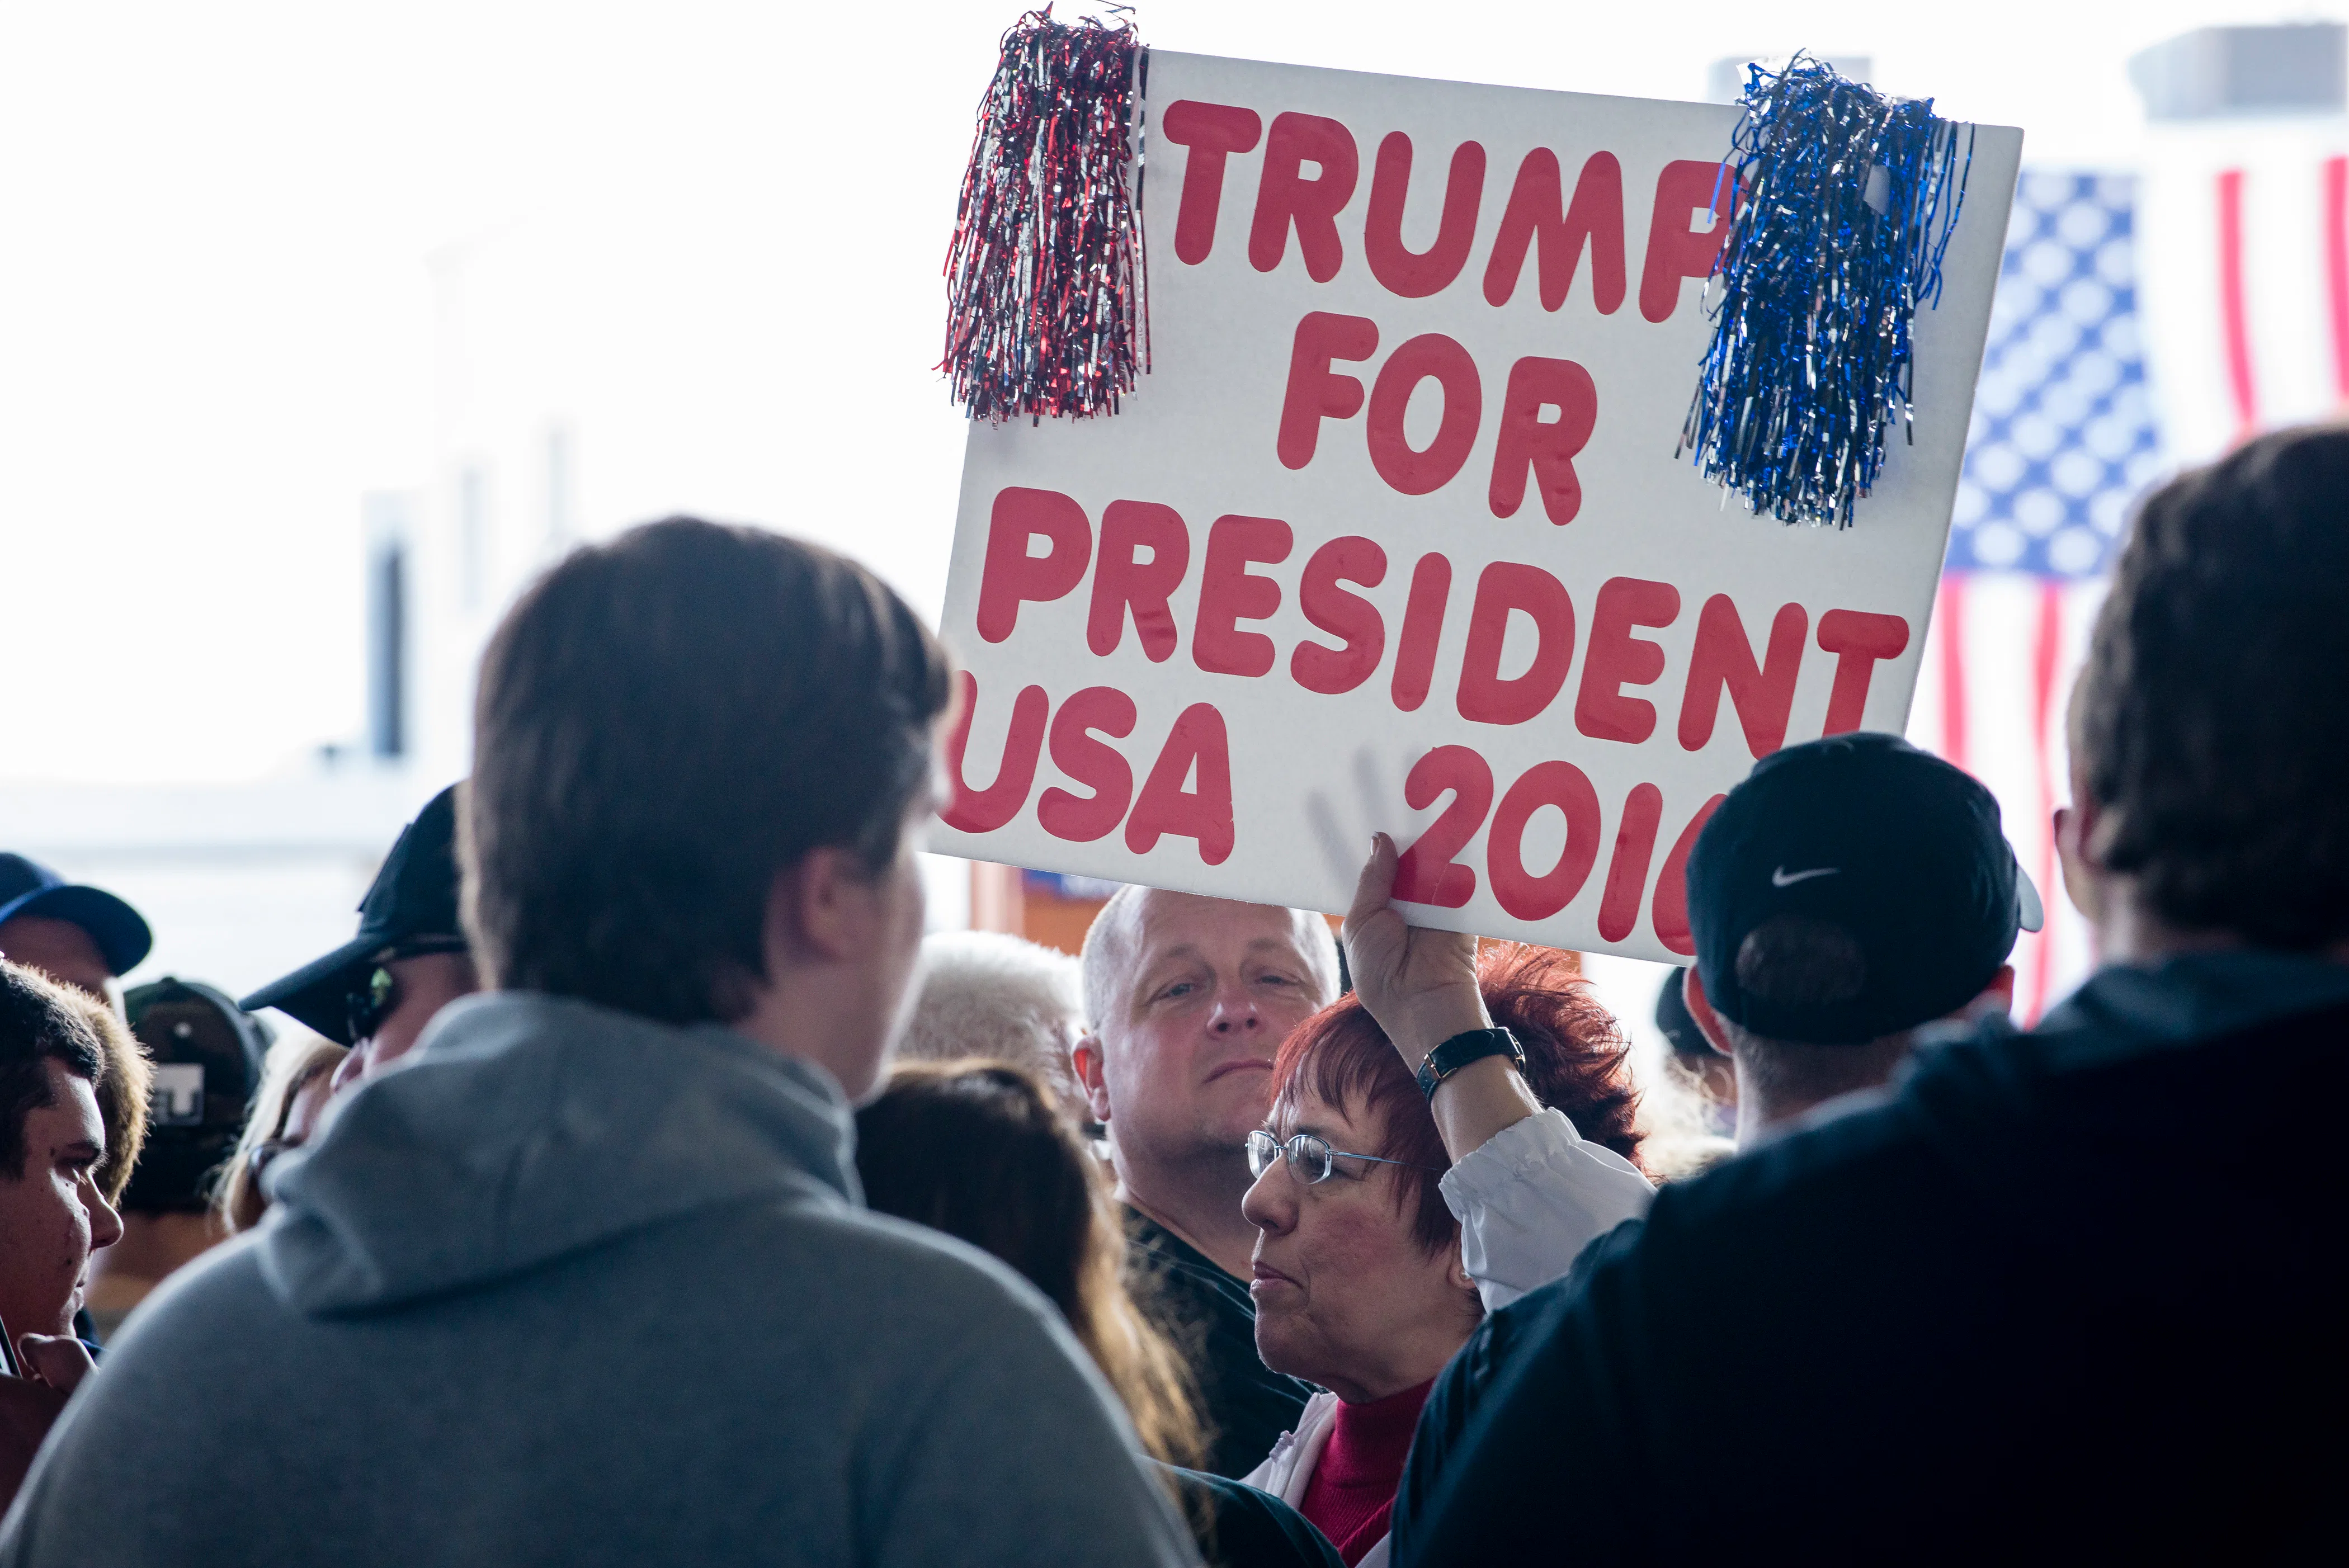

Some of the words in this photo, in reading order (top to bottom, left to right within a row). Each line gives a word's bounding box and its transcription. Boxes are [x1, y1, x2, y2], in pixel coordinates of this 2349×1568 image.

[1163, 100, 1751, 324] TRUMP
[1277, 311, 1597, 526] FOR
[977, 487, 1909, 761] PRESIDENT
[935, 670, 1235, 866] USA
